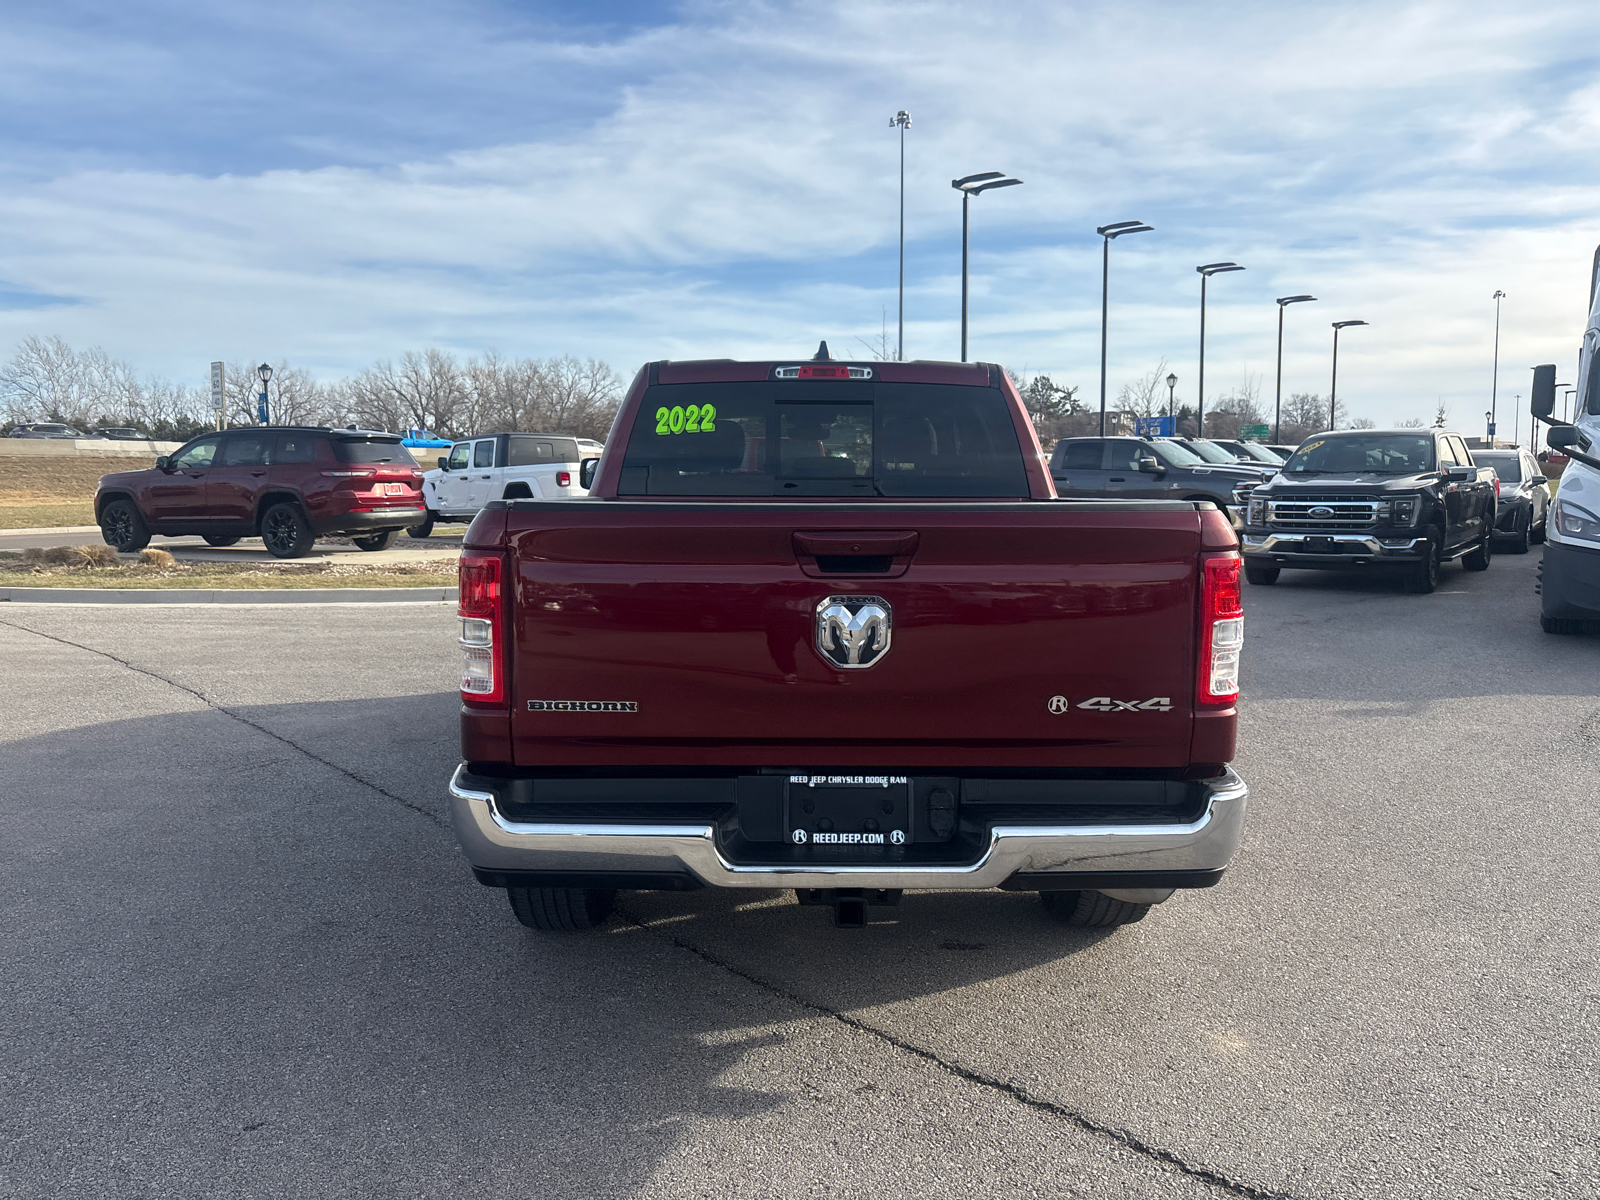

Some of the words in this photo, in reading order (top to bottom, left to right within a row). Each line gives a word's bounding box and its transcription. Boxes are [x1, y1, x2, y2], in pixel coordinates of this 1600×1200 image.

[655, 403, 717, 436] 2022
[527, 700, 638, 713] BIGHORN
[1076, 697, 1175, 712] 4x4
[790, 775, 808, 784] REED
[810, 775, 826, 784] JEEP
[828, 775, 863, 784] CHRYSLER
[865, 776, 888, 784] DODGE
[890, 776, 907, 784] RAM
[812, 833, 884, 844] REEDJEEP.COM
